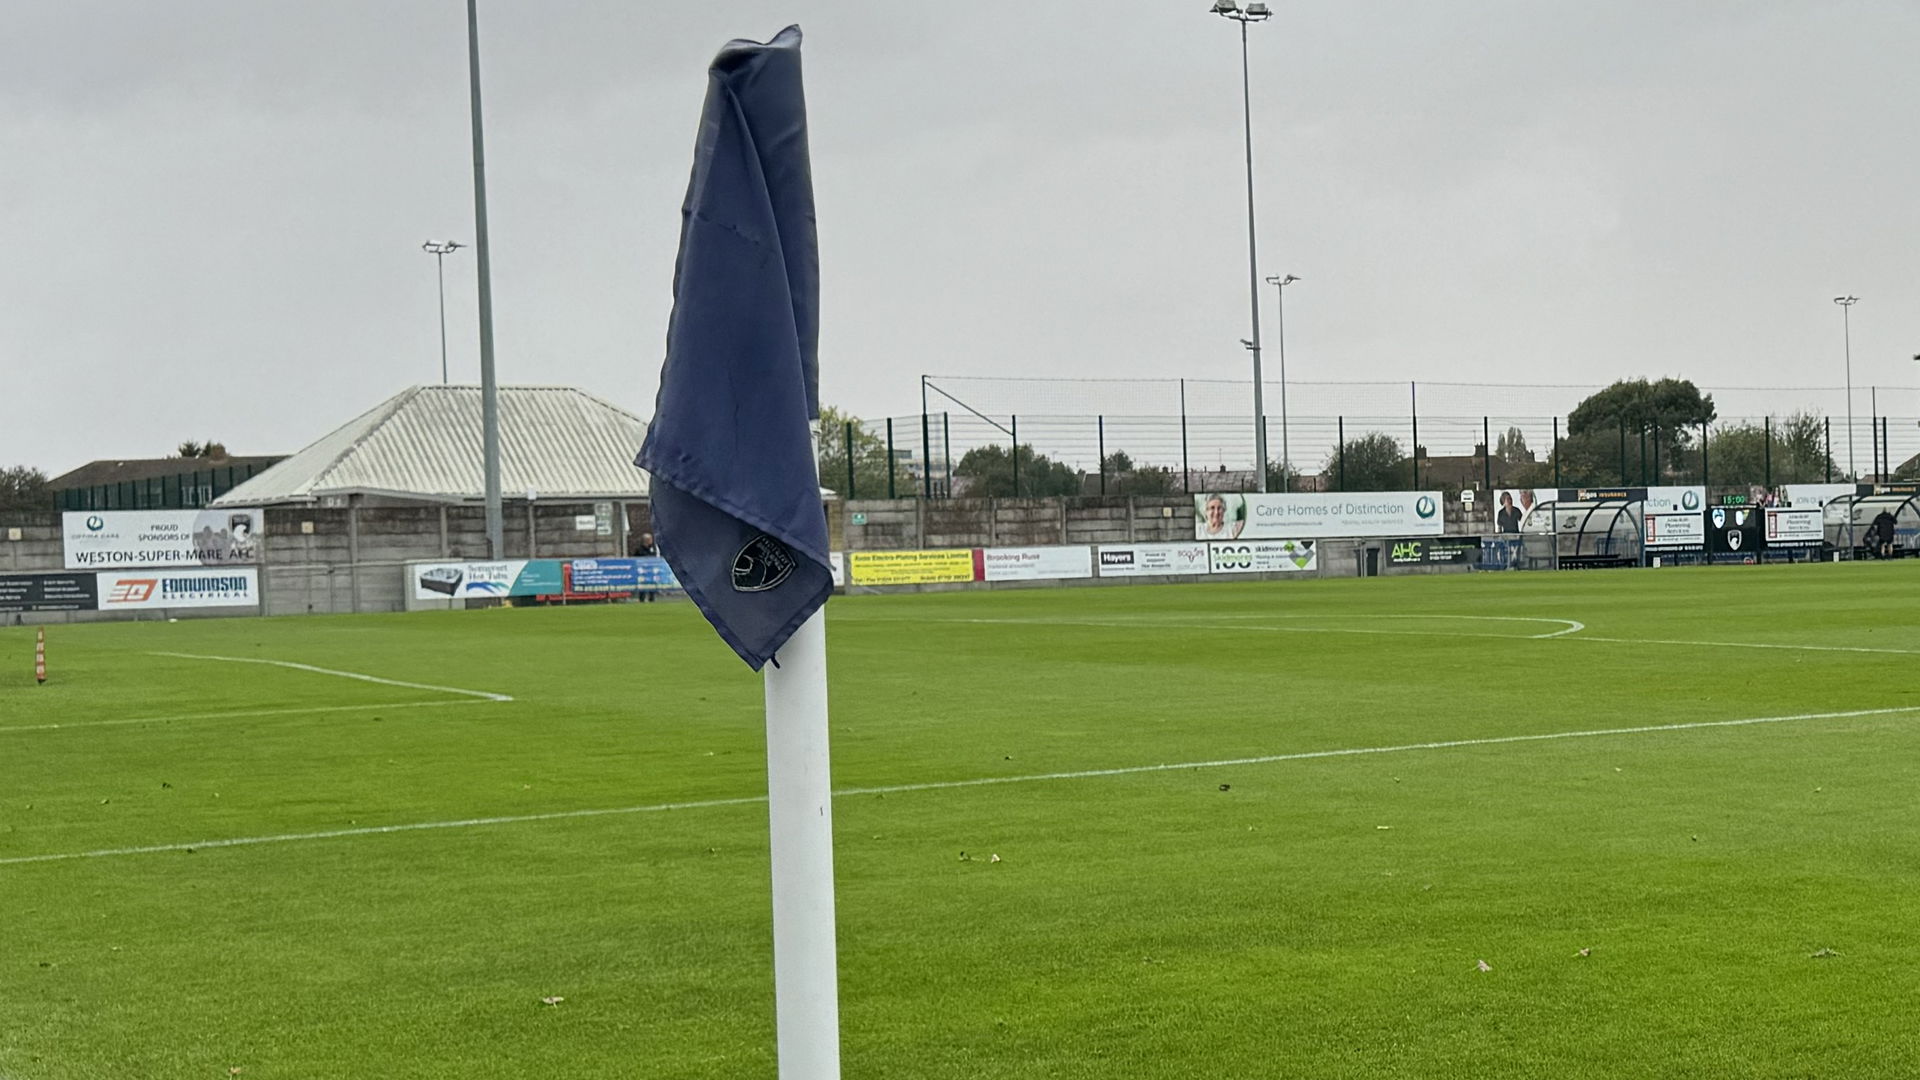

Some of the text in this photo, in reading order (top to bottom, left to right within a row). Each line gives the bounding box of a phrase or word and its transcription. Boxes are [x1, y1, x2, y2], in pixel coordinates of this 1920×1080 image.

[1256, 503, 1404, 517] Care Homes of Distinction
[76, 549, 255, 563] WESTON-SUPER-MARE AFC
[1391, 541, 1423, 558] AHC
[1212, 546, 1252, 570] 100
[162, 576, 248, 592] EDMUNDSON
[162, 592, 248, 600] ELECTRICAL
